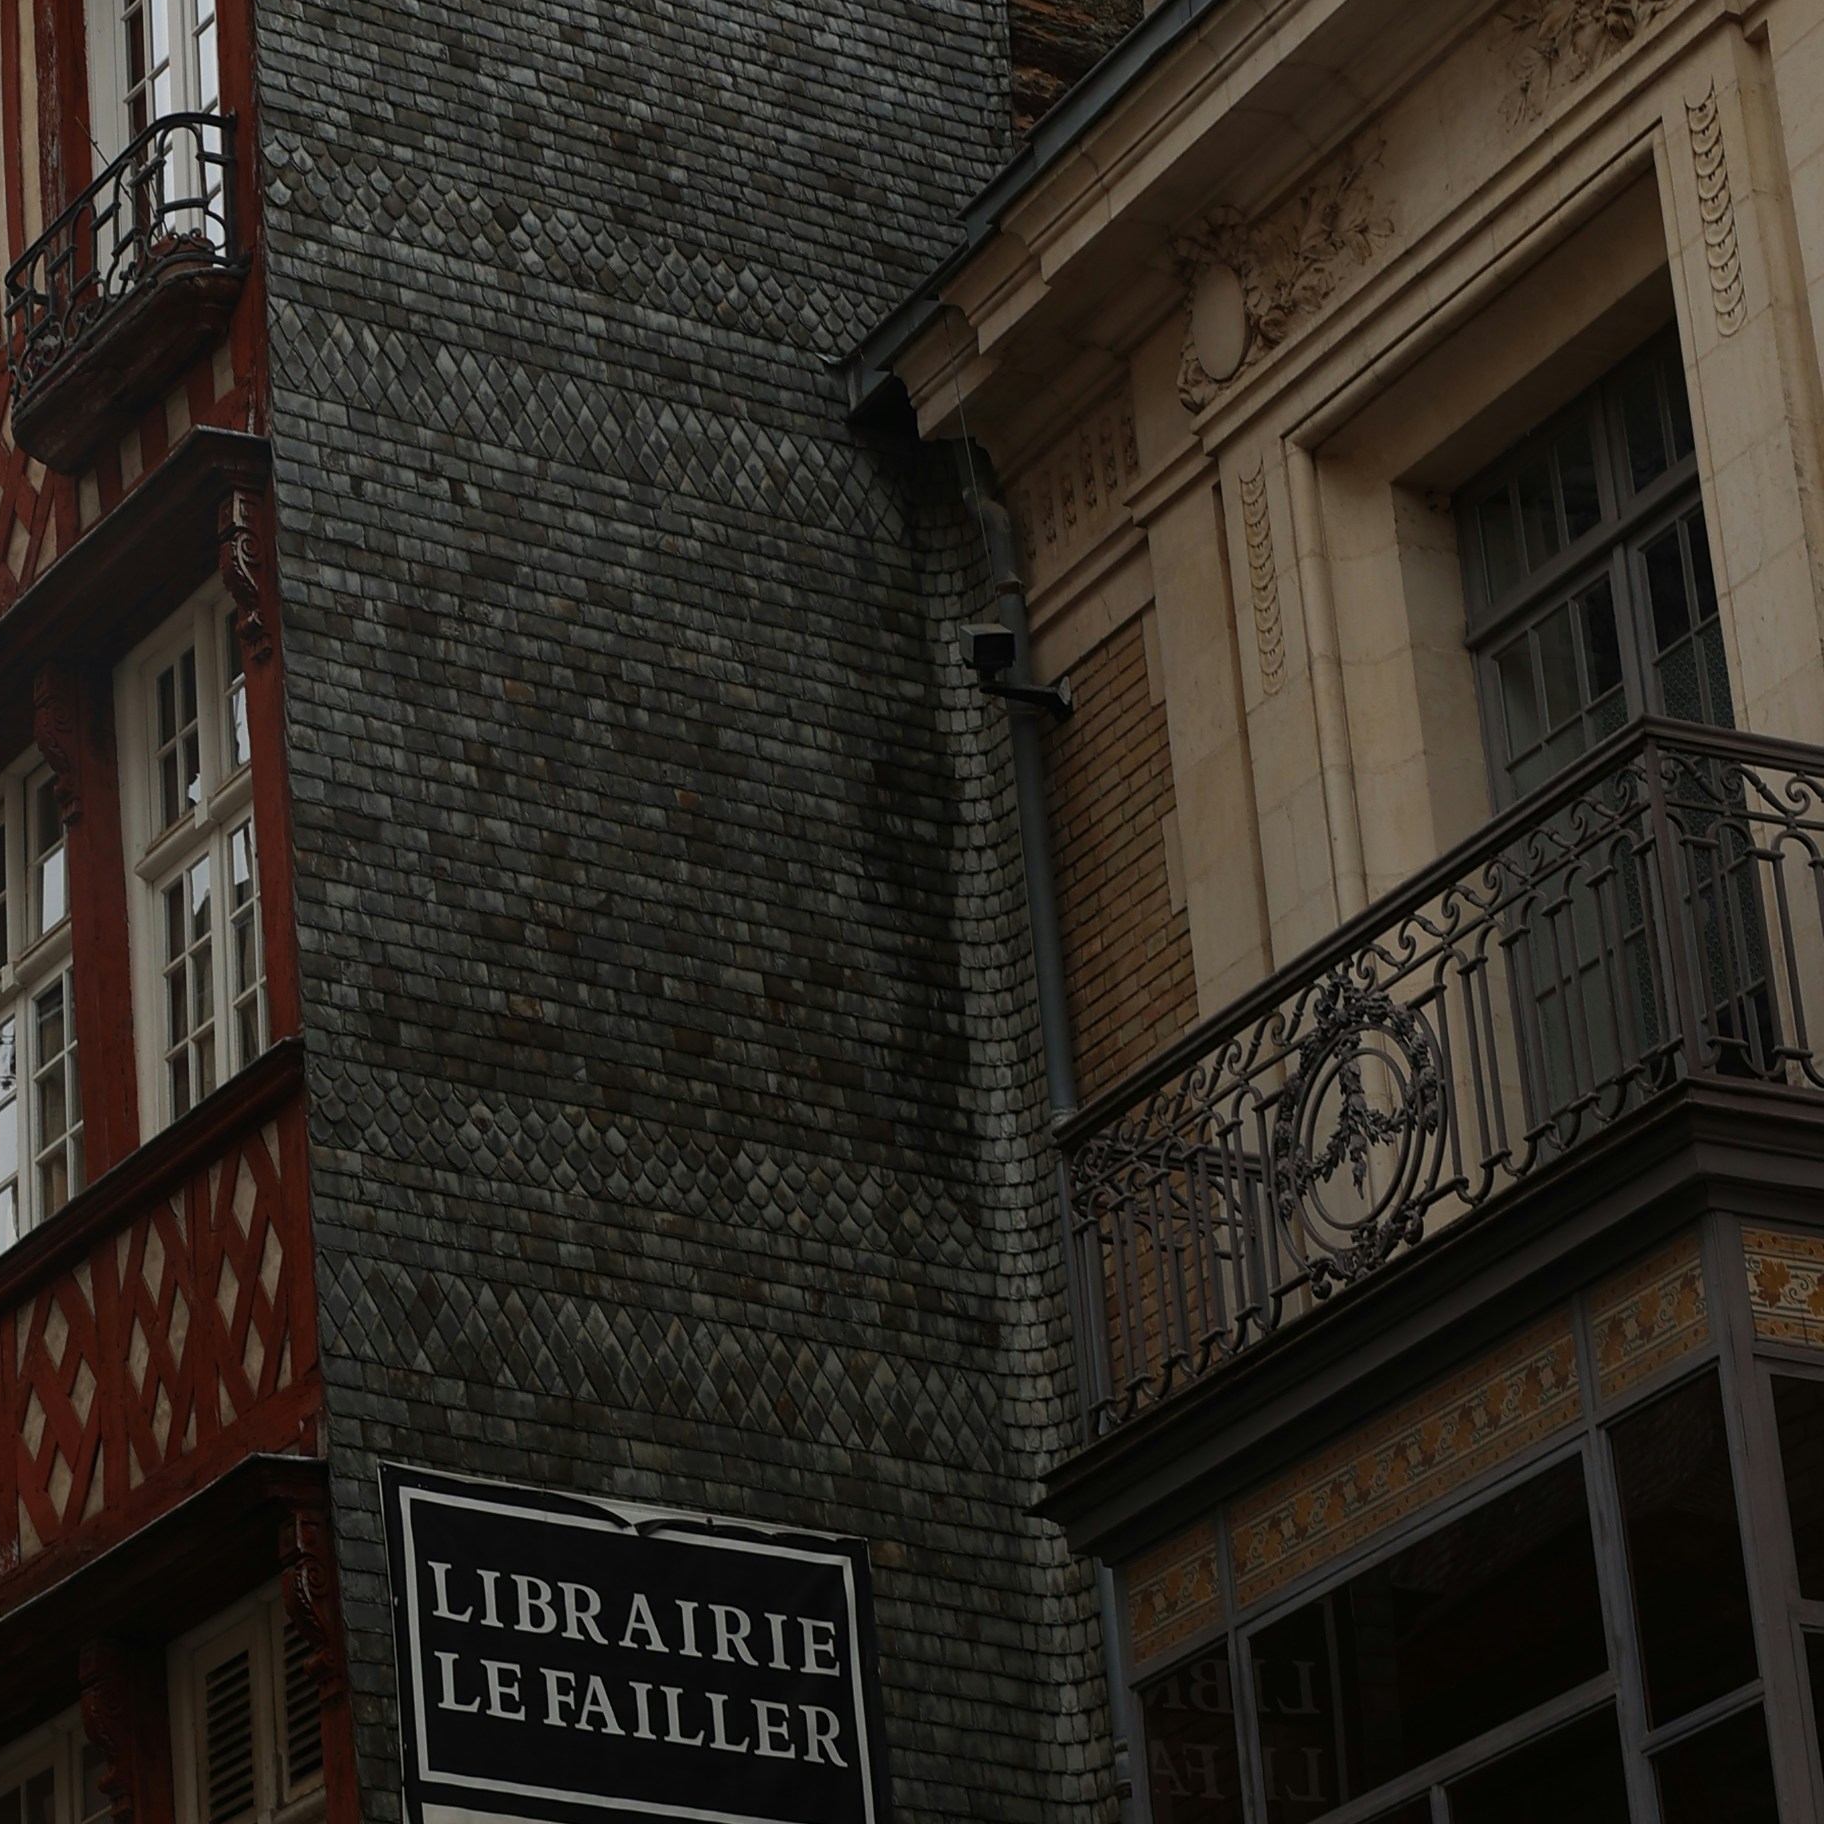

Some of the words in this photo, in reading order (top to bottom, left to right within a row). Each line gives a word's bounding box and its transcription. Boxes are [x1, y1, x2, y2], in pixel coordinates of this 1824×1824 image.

[426, 1559, 841, 1677] LIBRAIRIE
[433, 1649, 527, 1722] LE
[539, 1666, 849, 1769] FAILLER
